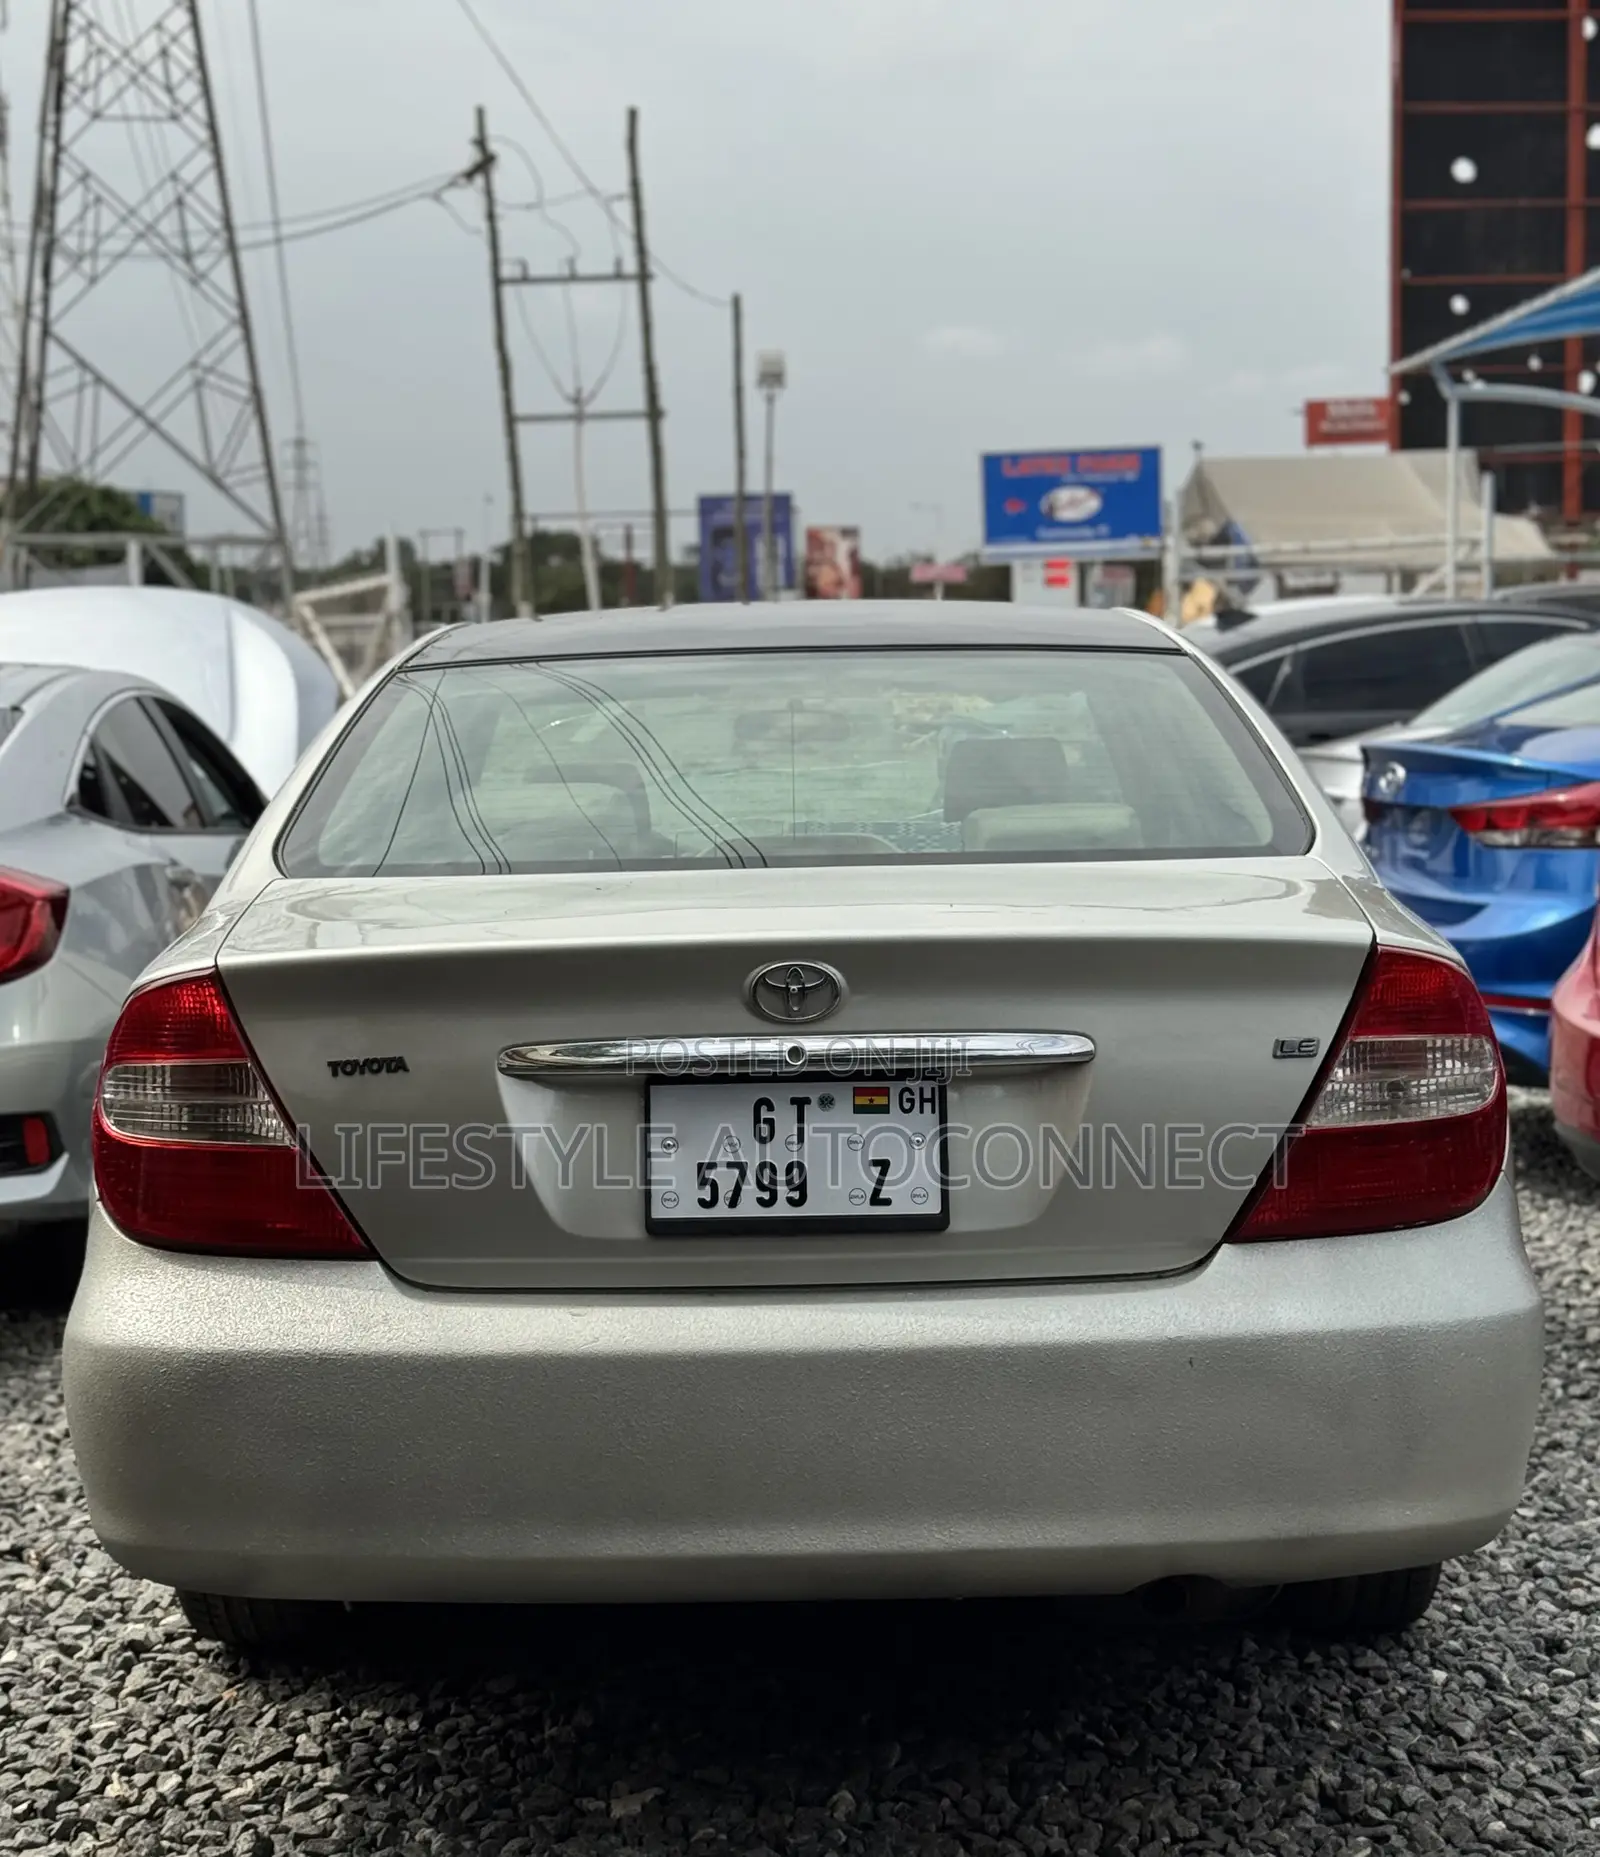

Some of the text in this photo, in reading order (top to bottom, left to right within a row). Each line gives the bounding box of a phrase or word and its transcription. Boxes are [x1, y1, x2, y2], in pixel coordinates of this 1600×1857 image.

[1279, 1038, 1317, 1054] LE
[327, 1056, 410, 1077] TOYOTA
[898, 1087, 936, 1115] GH
[753, 1096, 812, 1145] GT
[696, 1159, 892, 1208] 5799 Z
